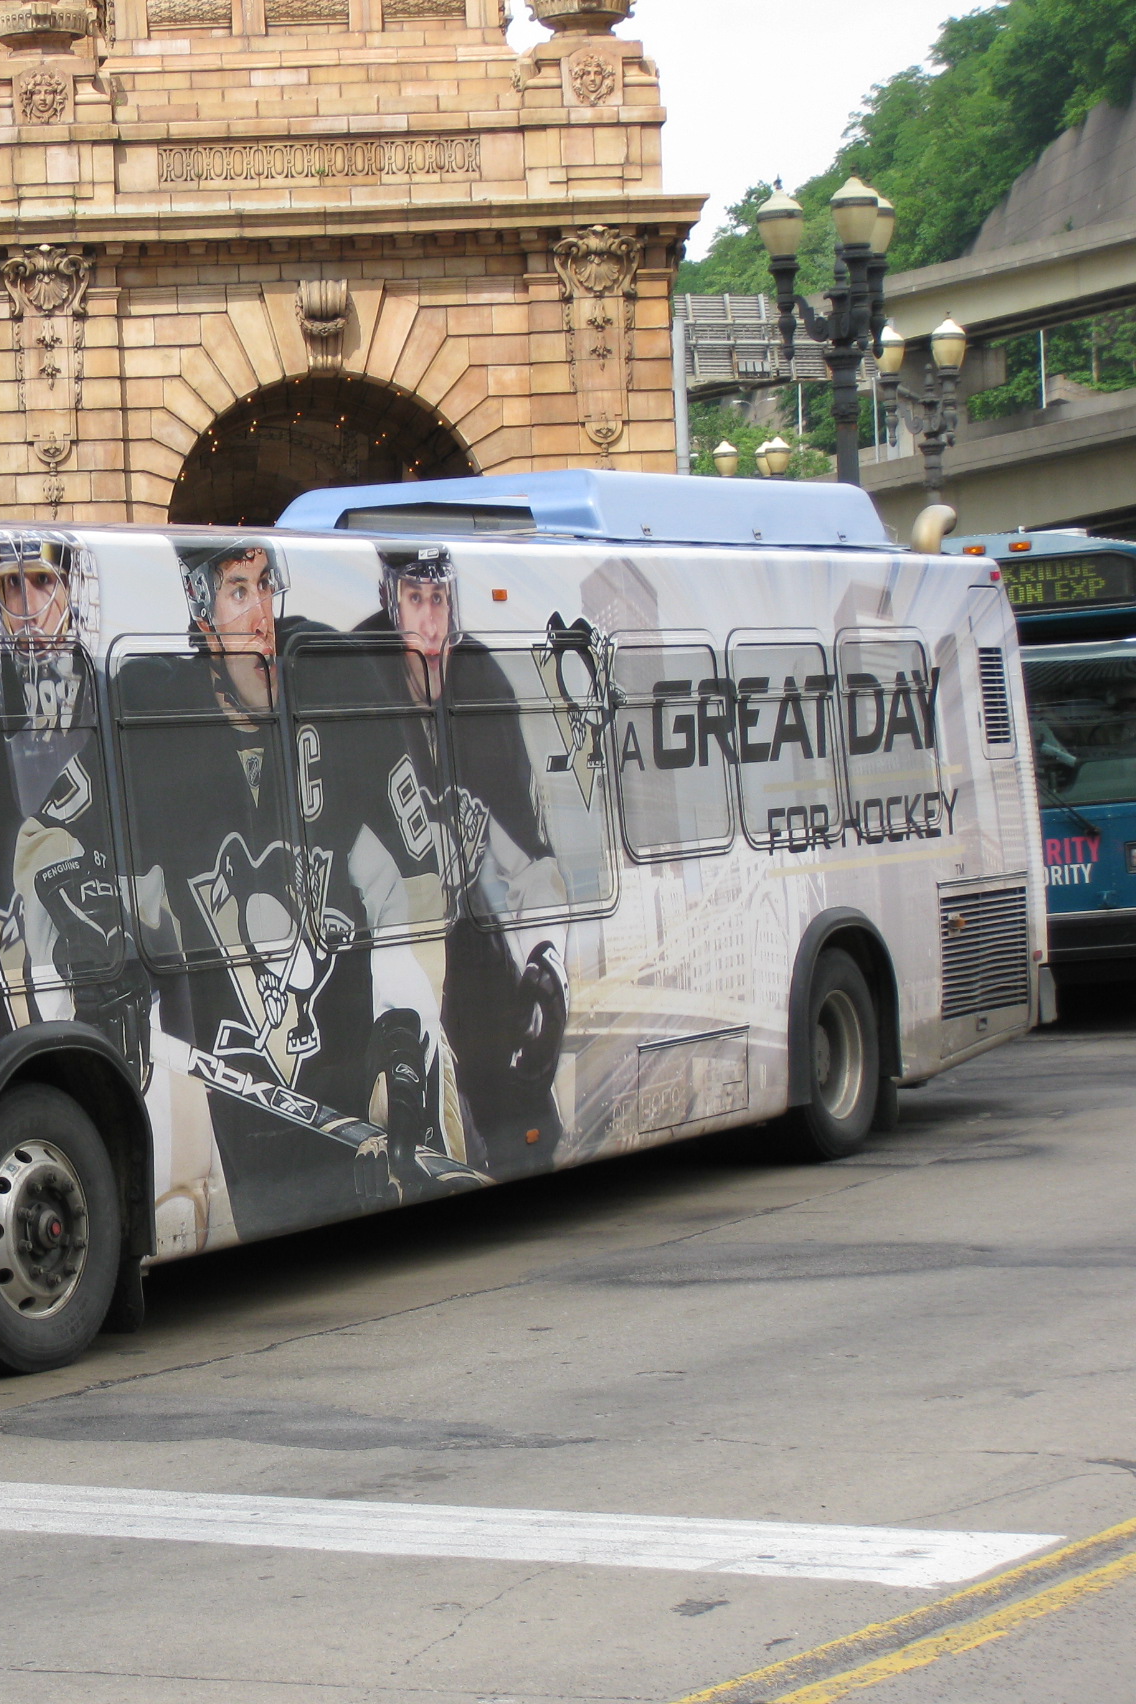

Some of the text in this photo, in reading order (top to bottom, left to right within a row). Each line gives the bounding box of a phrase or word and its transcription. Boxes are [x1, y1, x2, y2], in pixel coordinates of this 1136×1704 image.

[1054, 577, 1105, 600] EXP
[620, 667, 941, 772] A GREAT DAY
[767, 788, 959, 856] FOR HOCKEY
[93, 850, 107, 869] 87
[1046, 836, 1101, 865] RITY
[42, 861, 80, 882] PENGUINS
